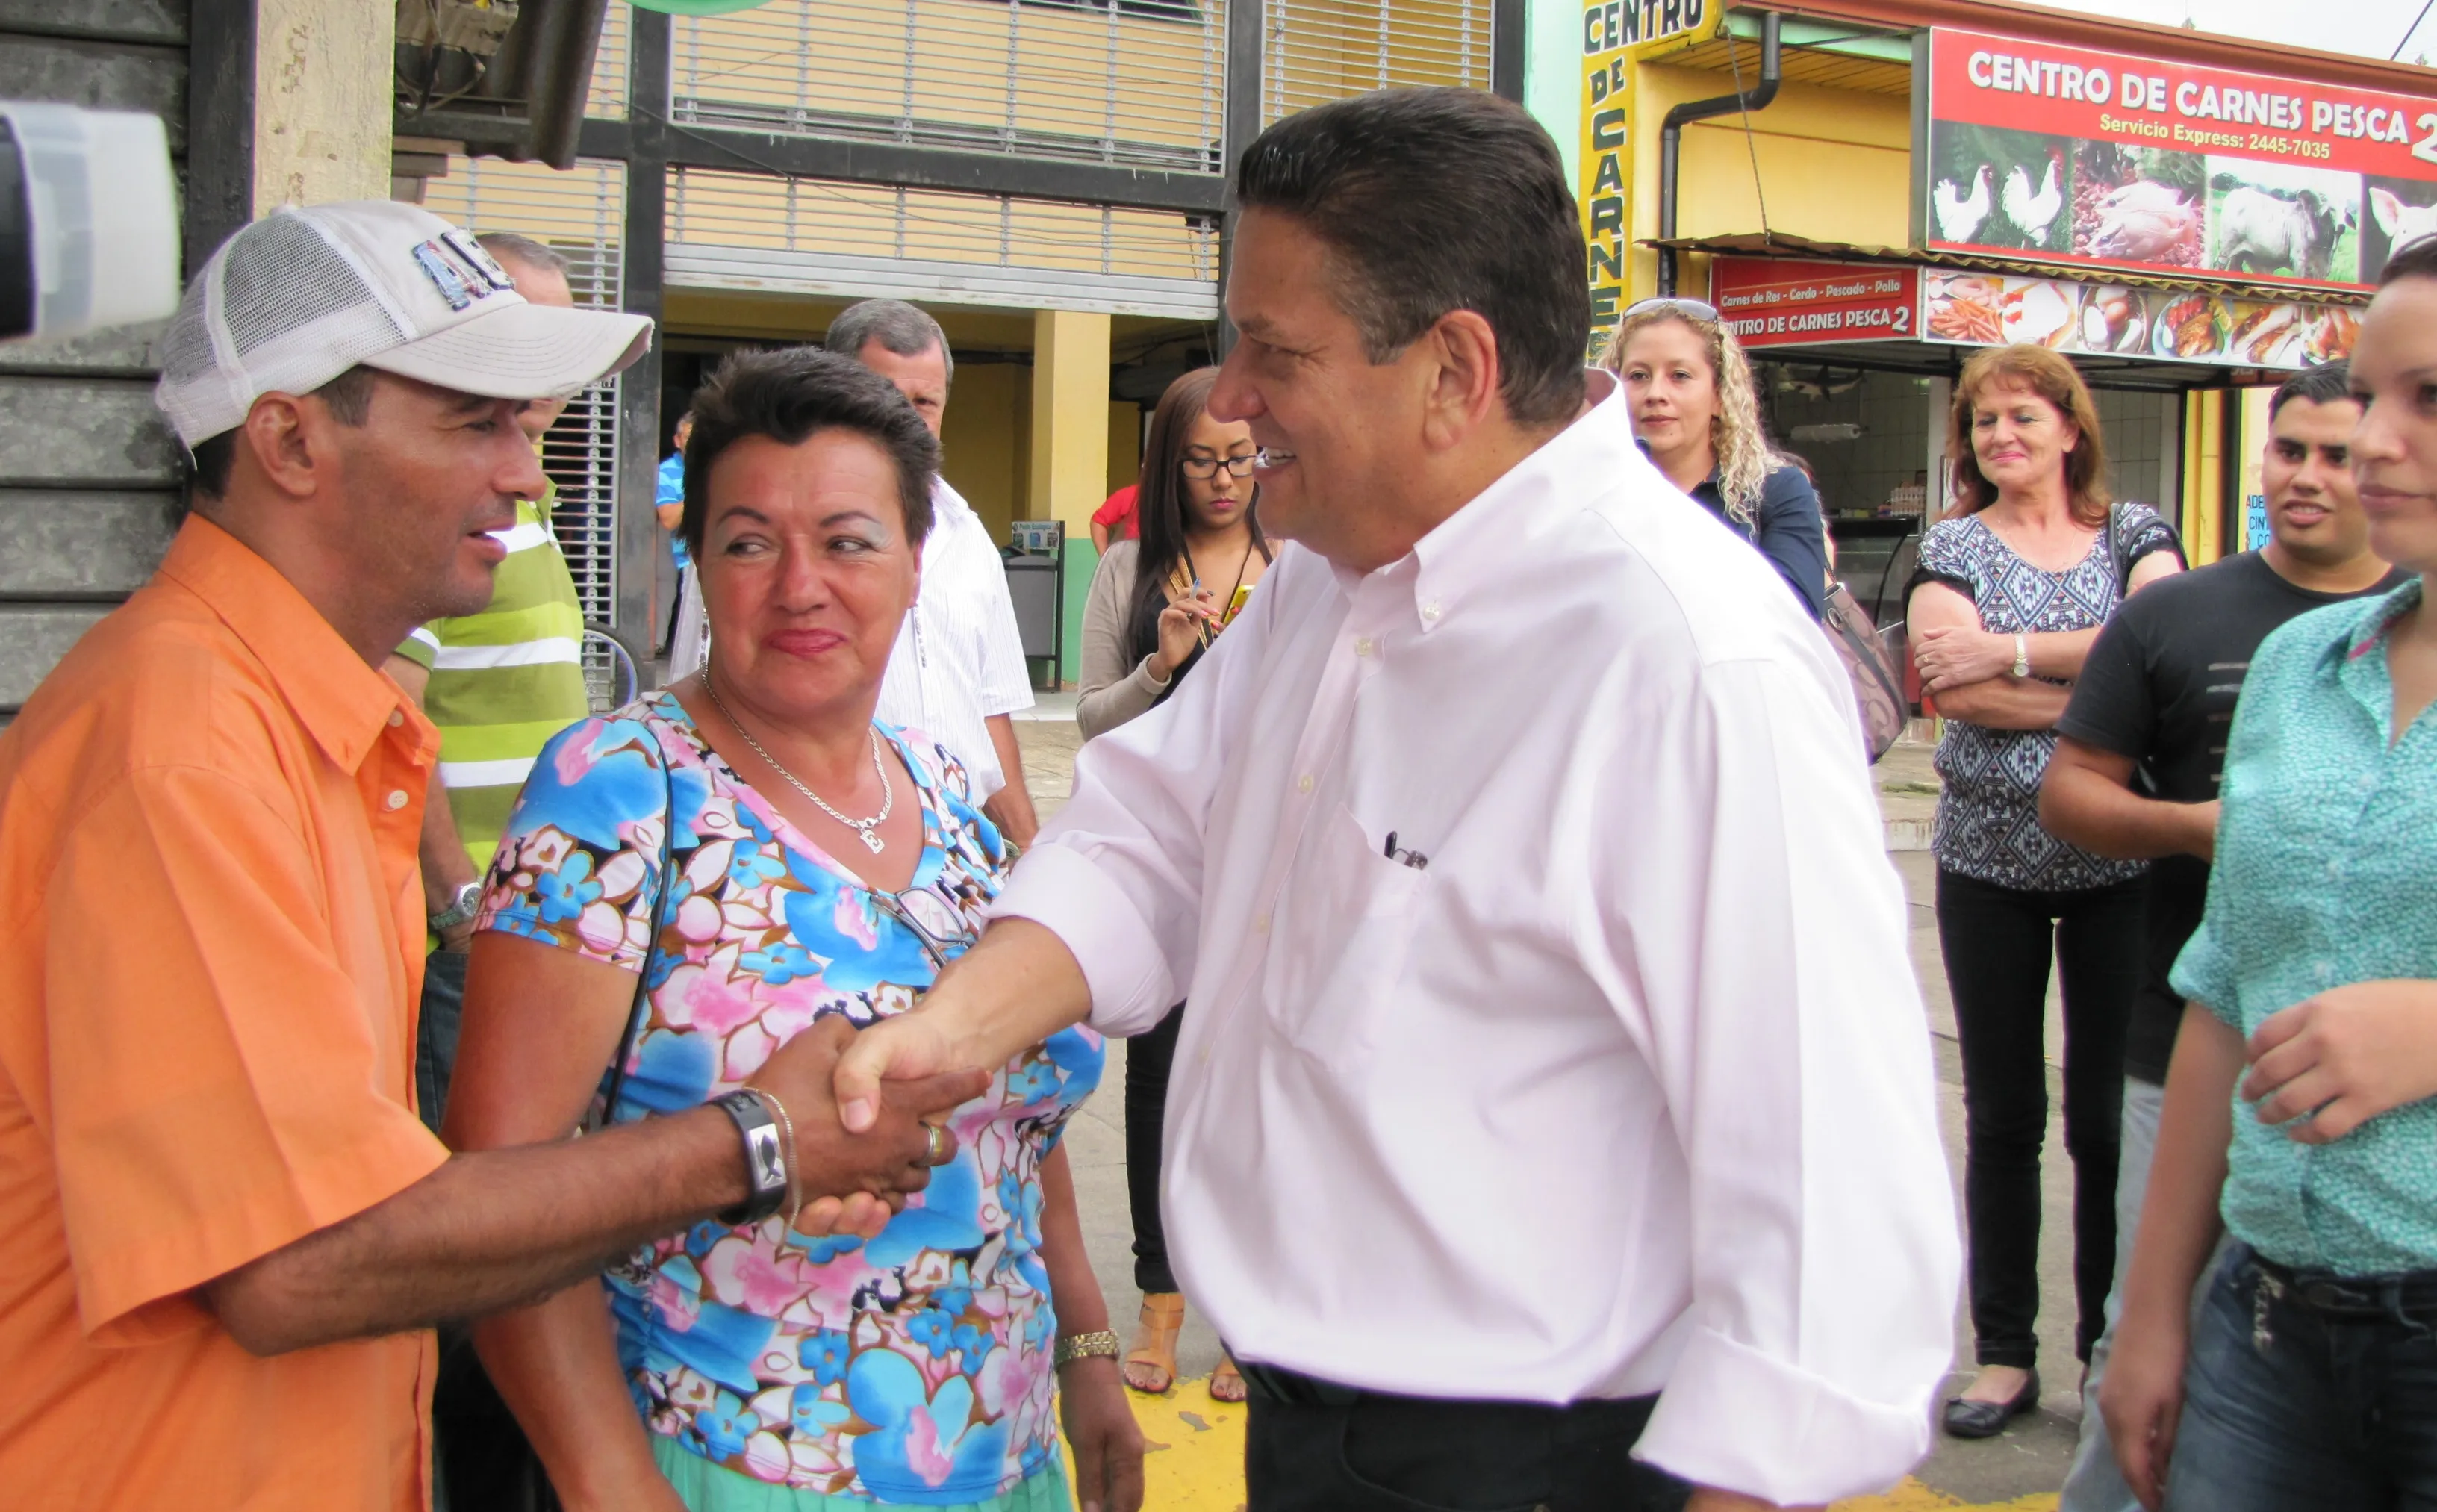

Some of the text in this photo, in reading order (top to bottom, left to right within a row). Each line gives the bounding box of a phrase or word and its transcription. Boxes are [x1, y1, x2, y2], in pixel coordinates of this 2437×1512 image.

[1589, 55, 1625, 108] DE
[1967, 51, 2437, 164] CENTRO DE CARNES PESCA 2
[2100, 113, 2331, 159] Servicio Express: 2445-7035
[1721, 295, 1750, 308] Carnes
[1752, 291, 1764, 304] de
[1766, 290, 1781, 303] Res
[1790, 287, 1817, 301] Cerdo
[1826, 282, 1865, 297] Pescado
[1875, 279, 1900, 293] Pollo
[1728, 306, 1910, 336] NTRO DE CARNES PESCA 2
